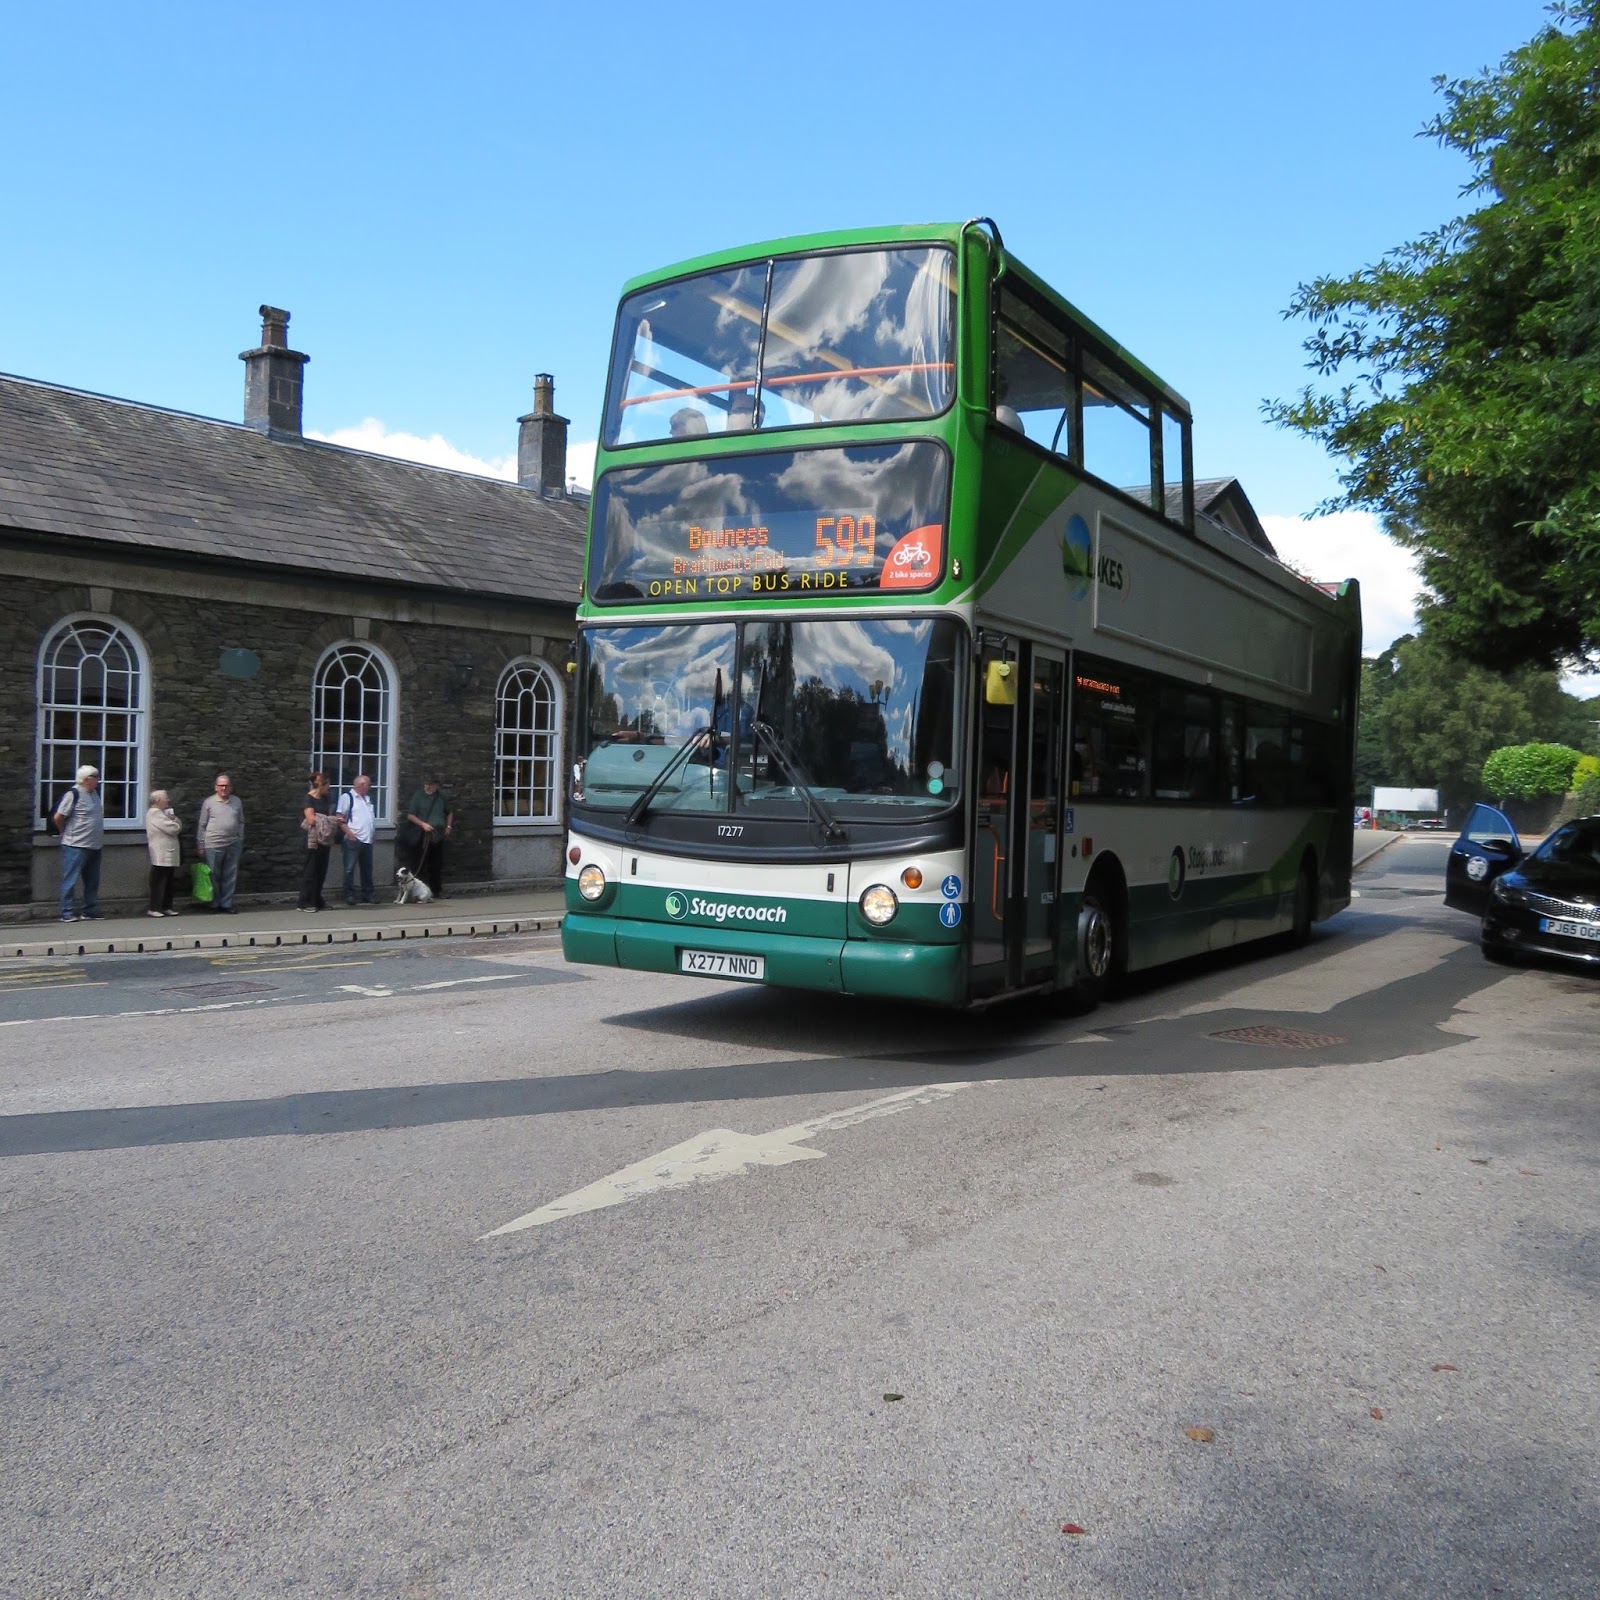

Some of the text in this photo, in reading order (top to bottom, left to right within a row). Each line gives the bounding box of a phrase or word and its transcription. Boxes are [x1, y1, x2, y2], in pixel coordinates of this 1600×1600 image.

[689, 526, 769, 550] Bowness
[815, 515, 876, 566] 599
[673, 550, 785, 574] Braithwaite Fold
[1087, 544, 1123, 590] LKES
[650, 571, 848, 596] OPEN TOP BUS RIDE
[889, 571, 932, 580] 2 bike spaces
[718, 825, 744, 837] 17277
[690, 897, 787, 923] Stagecoach
[1547, 921, 1577, 935] PJ65
[688, 953, 758, 975] X277 NNO
